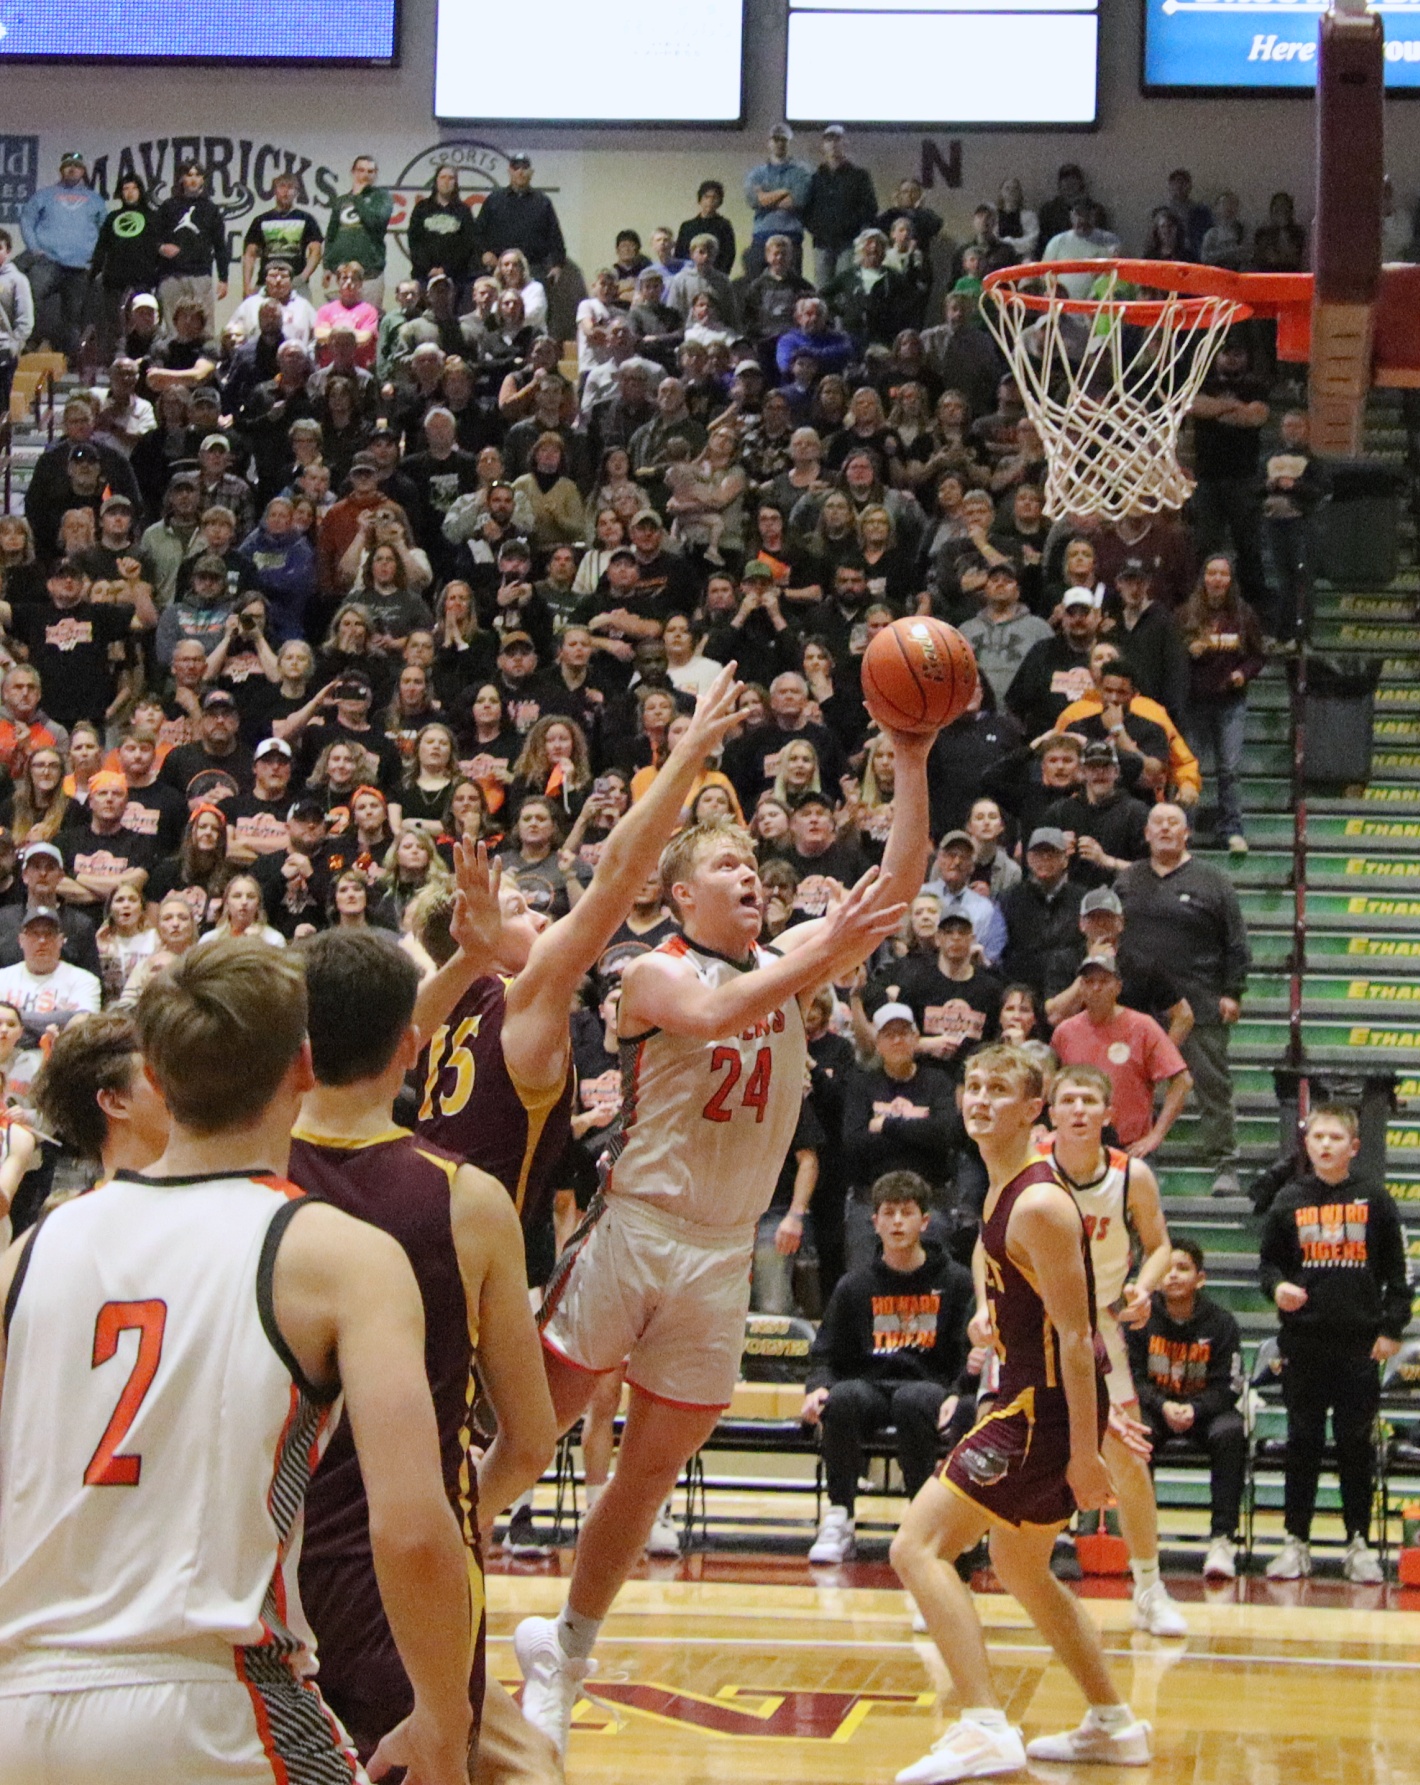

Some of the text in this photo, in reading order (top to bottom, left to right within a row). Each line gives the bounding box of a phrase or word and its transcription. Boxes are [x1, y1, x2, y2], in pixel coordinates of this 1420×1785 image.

[428, 149, 498, 172] SPORTS
[919, 139, 962, 189] N
[418, 1013, 482, 1121] 15
[702, 1046, 772, 1123] 24
[1300, 1239, 1368, 1263] TIGERS
[83, 1298, 168, 1487] 2
